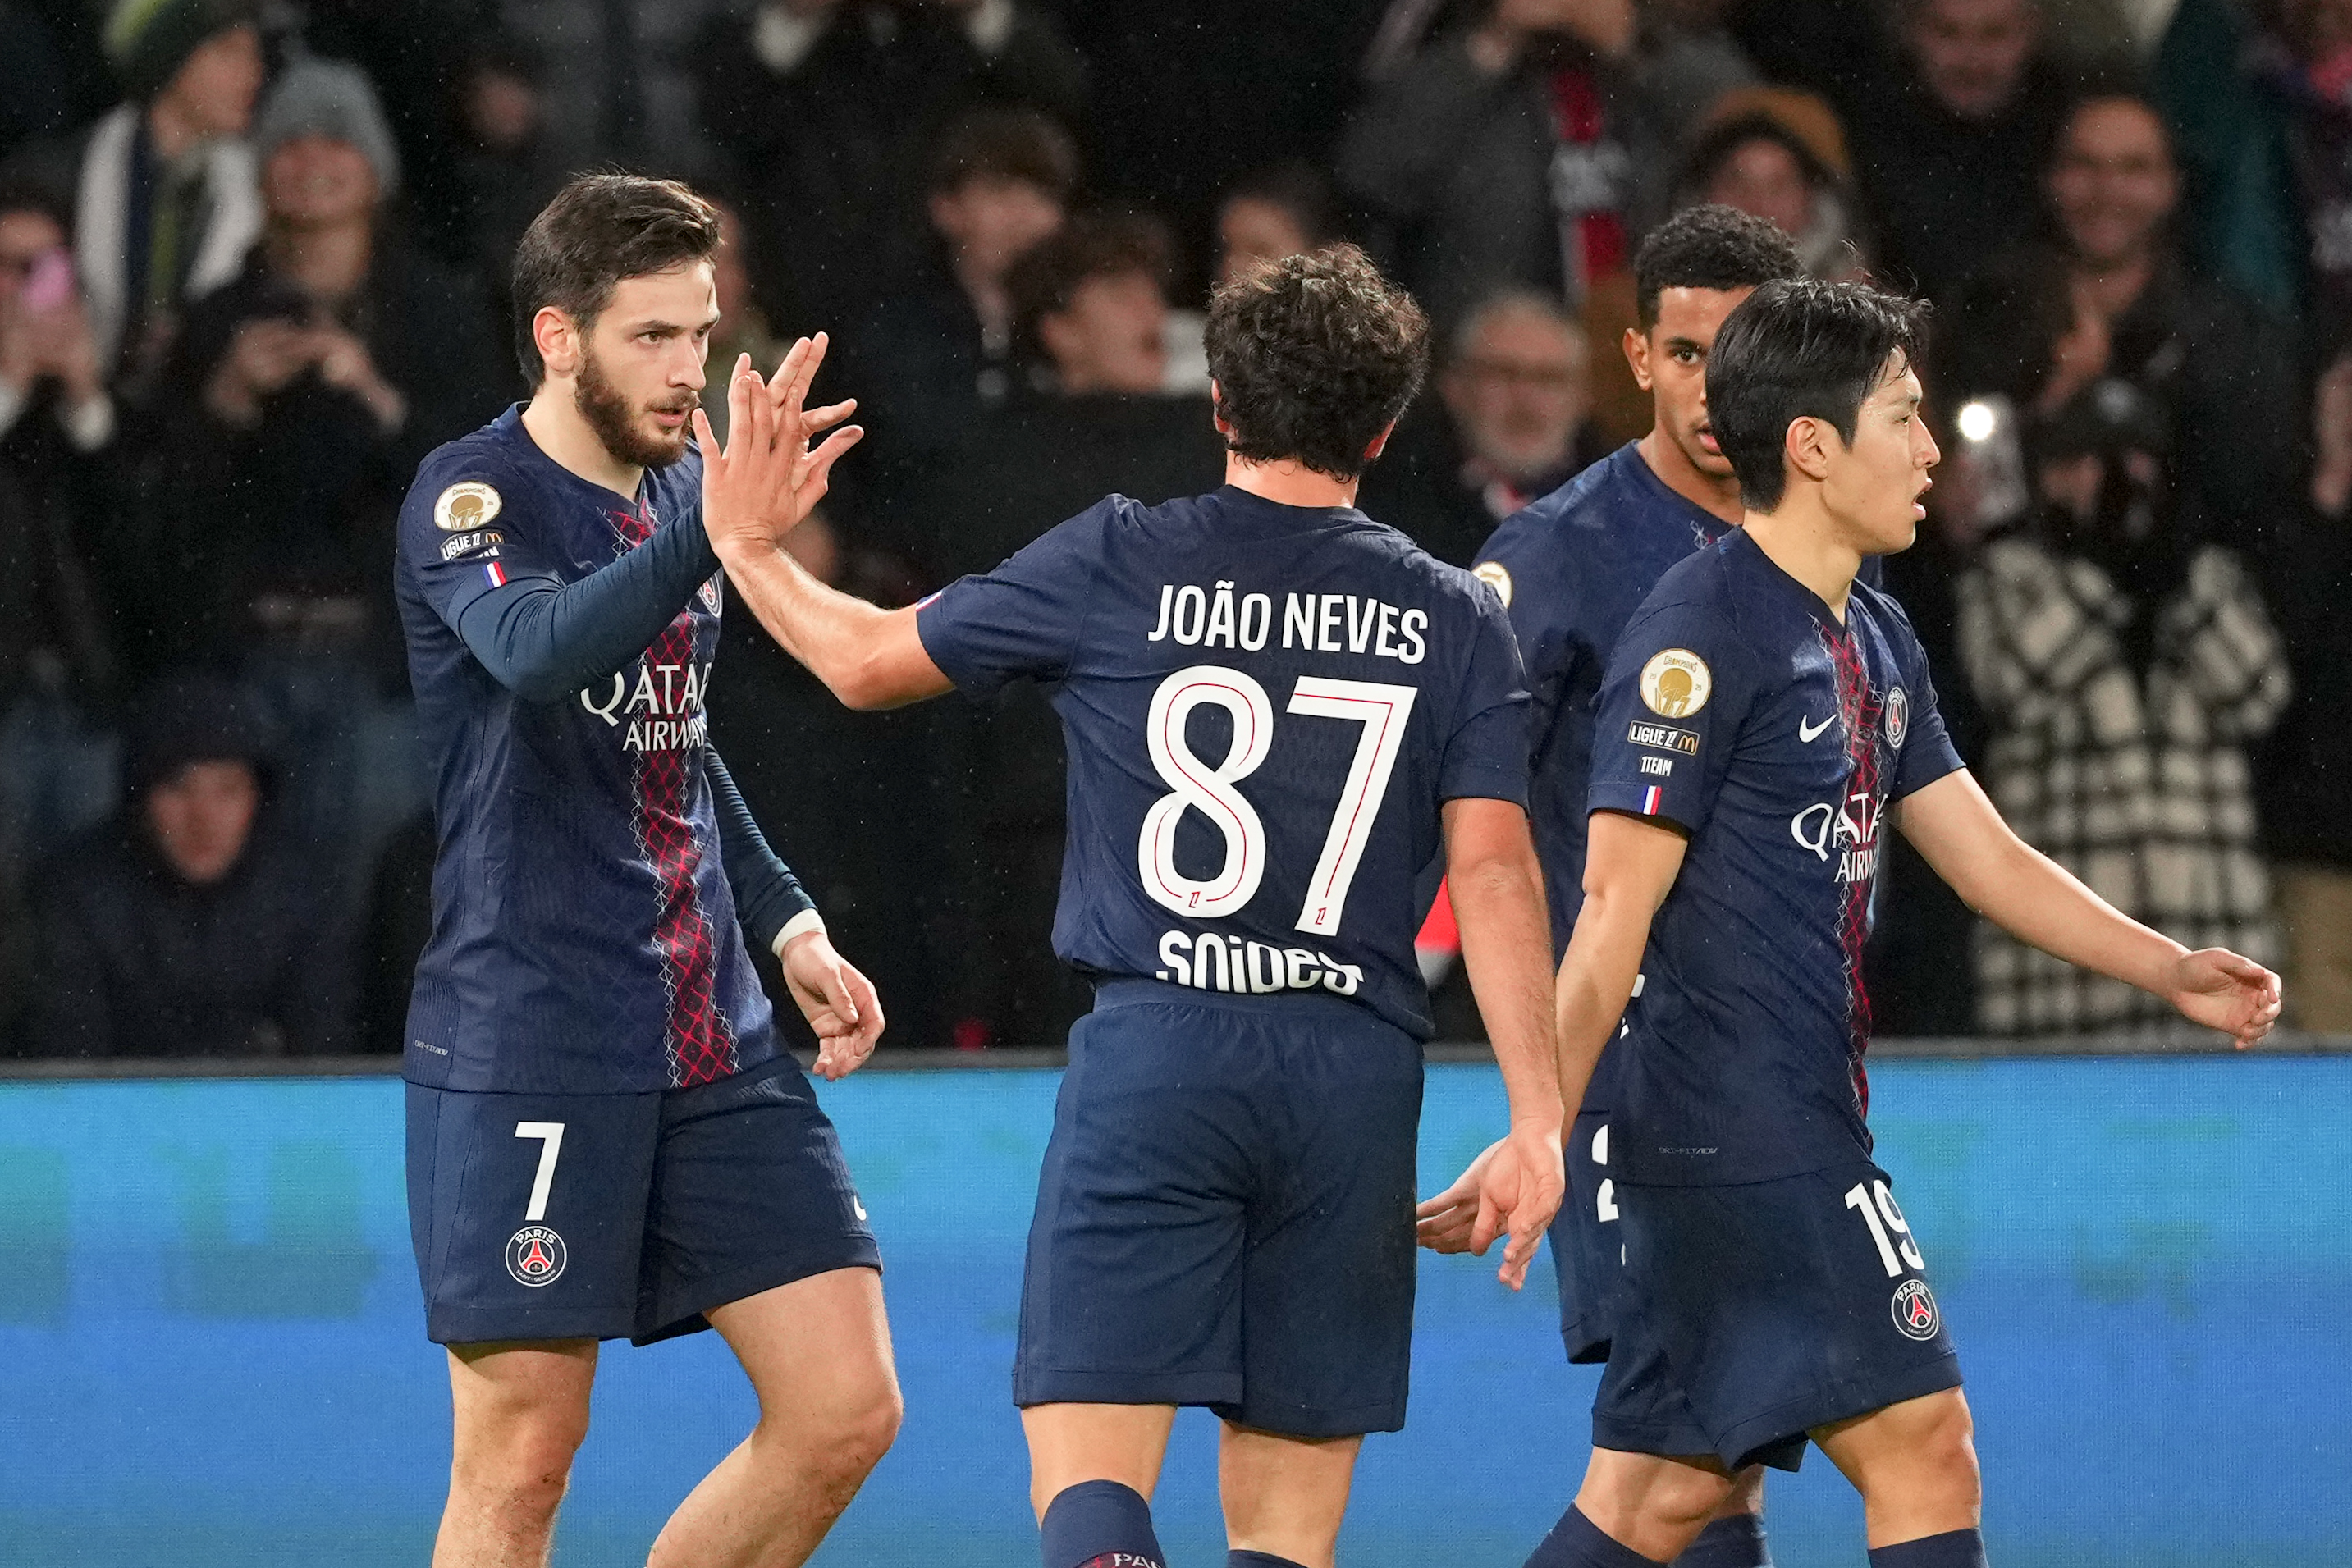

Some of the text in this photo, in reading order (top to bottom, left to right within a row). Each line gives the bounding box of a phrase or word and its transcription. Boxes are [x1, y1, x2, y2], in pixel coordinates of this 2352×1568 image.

[442, 535, 471, 560] LIGUE
[1147, 580, 1429, 665] JOÃO NEVES
[1630, 725, 1666, 746] LIGUE
[1640, 756, 1672, 777] 1TEAM
[1138, 665, 1417, 937] 87
[514, 1121, 565, 1221] 7
[515, 1229, 556, 1245] PARIS
[1844, 1179, 1926, 1278] 19
[1897, 1282, 1926, 1301] PARIS
